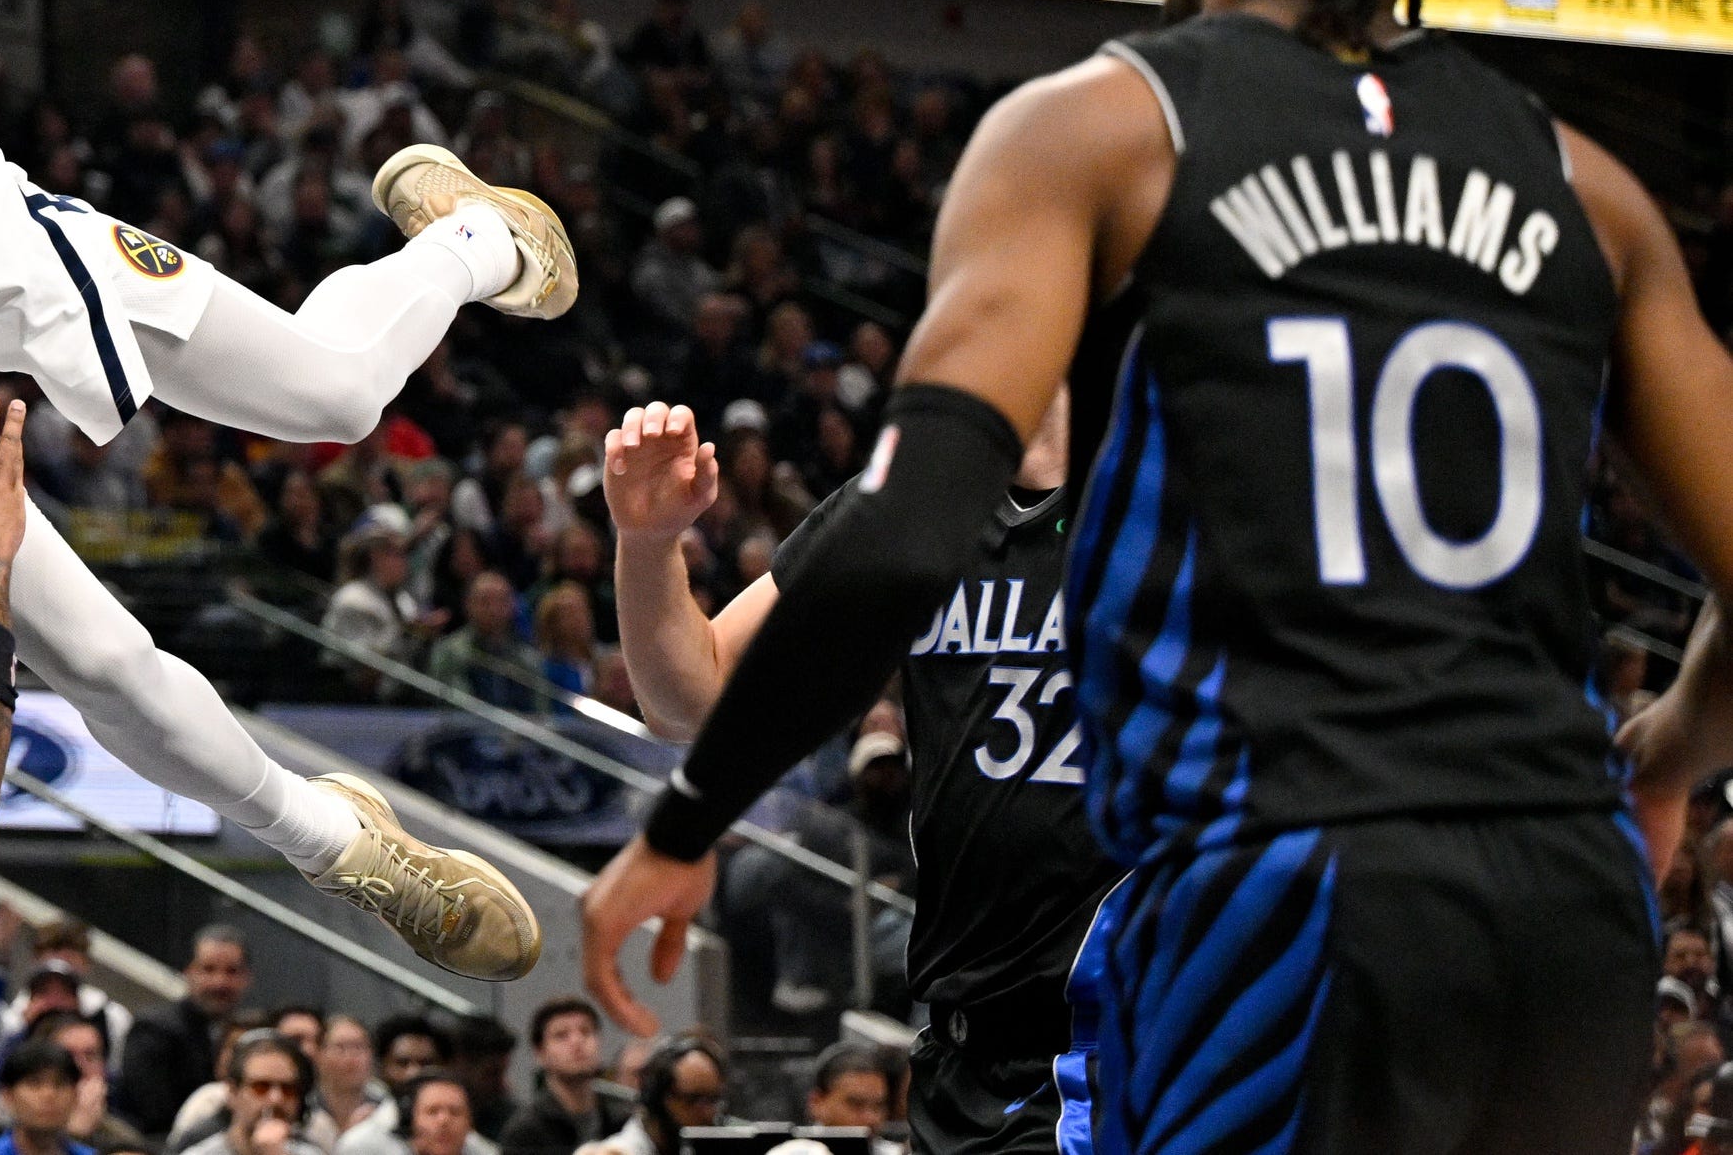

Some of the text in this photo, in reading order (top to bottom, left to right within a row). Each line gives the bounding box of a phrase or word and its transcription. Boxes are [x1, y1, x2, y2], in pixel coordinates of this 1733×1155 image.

[1209, 150, 1560, 296] WILLIAMS
[1267, 316, 1544, 591] 10
[909, 578, 1067, 656] ALLA
[974, 666, 1087, 785] 32
